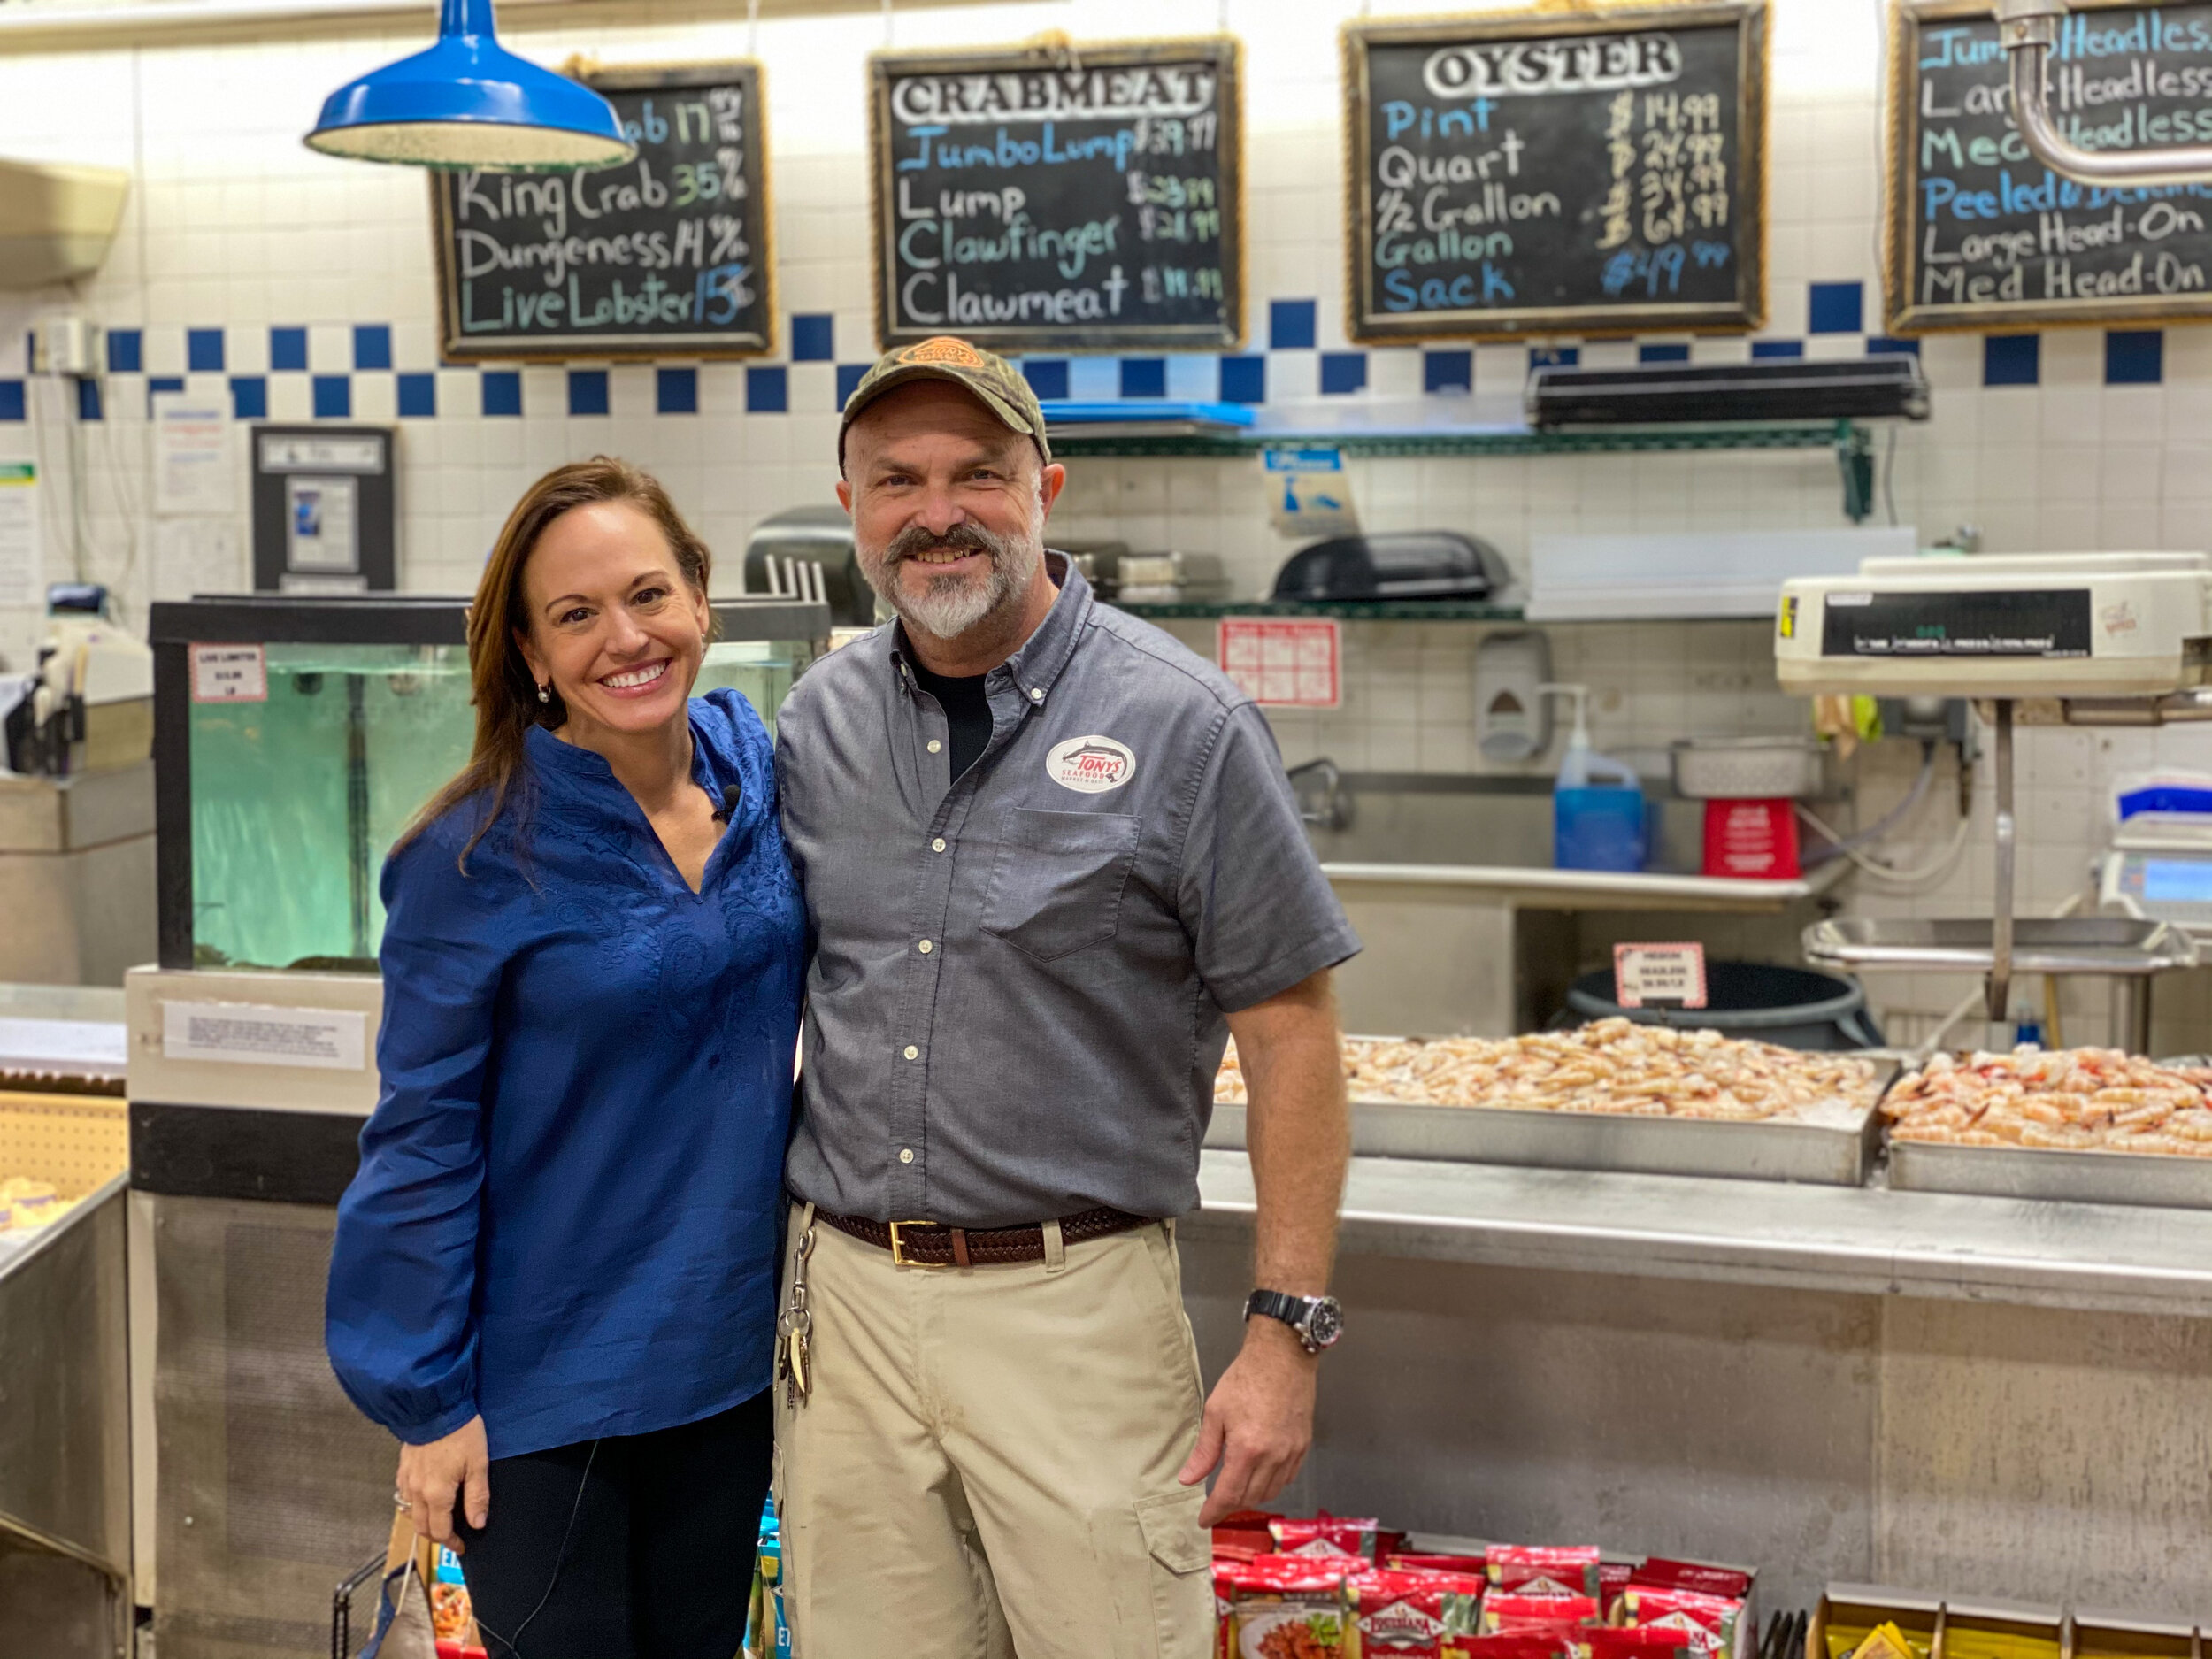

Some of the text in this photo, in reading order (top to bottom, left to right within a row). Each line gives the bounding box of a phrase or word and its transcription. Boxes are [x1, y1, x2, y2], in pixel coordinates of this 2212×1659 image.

[1432, 38, 1676, 90] OYSTER
[1918, 9, 2212, 70] Jum Headles
[901, 68, 1213, 115] CRABMEAT
[1381, 96, 1499, 141] Pint
[1378, 129, 1525, 190] Quart
[899, 177, 1026, 225] Lump
[1421, 182, 1561, 233] Gallon
[456, 228, 671, 288] Dungeness
[1374, 227, 1515, 269] Gallon
[1923, 224, 2037, 272] Large
[901, 265, 1130, 325] Clawmeat
[1383, 261, 1516, 311] Sack
[1921, 262, 2024, 306] Med
[1062, 769, 1105, 780] SEAFOOD
